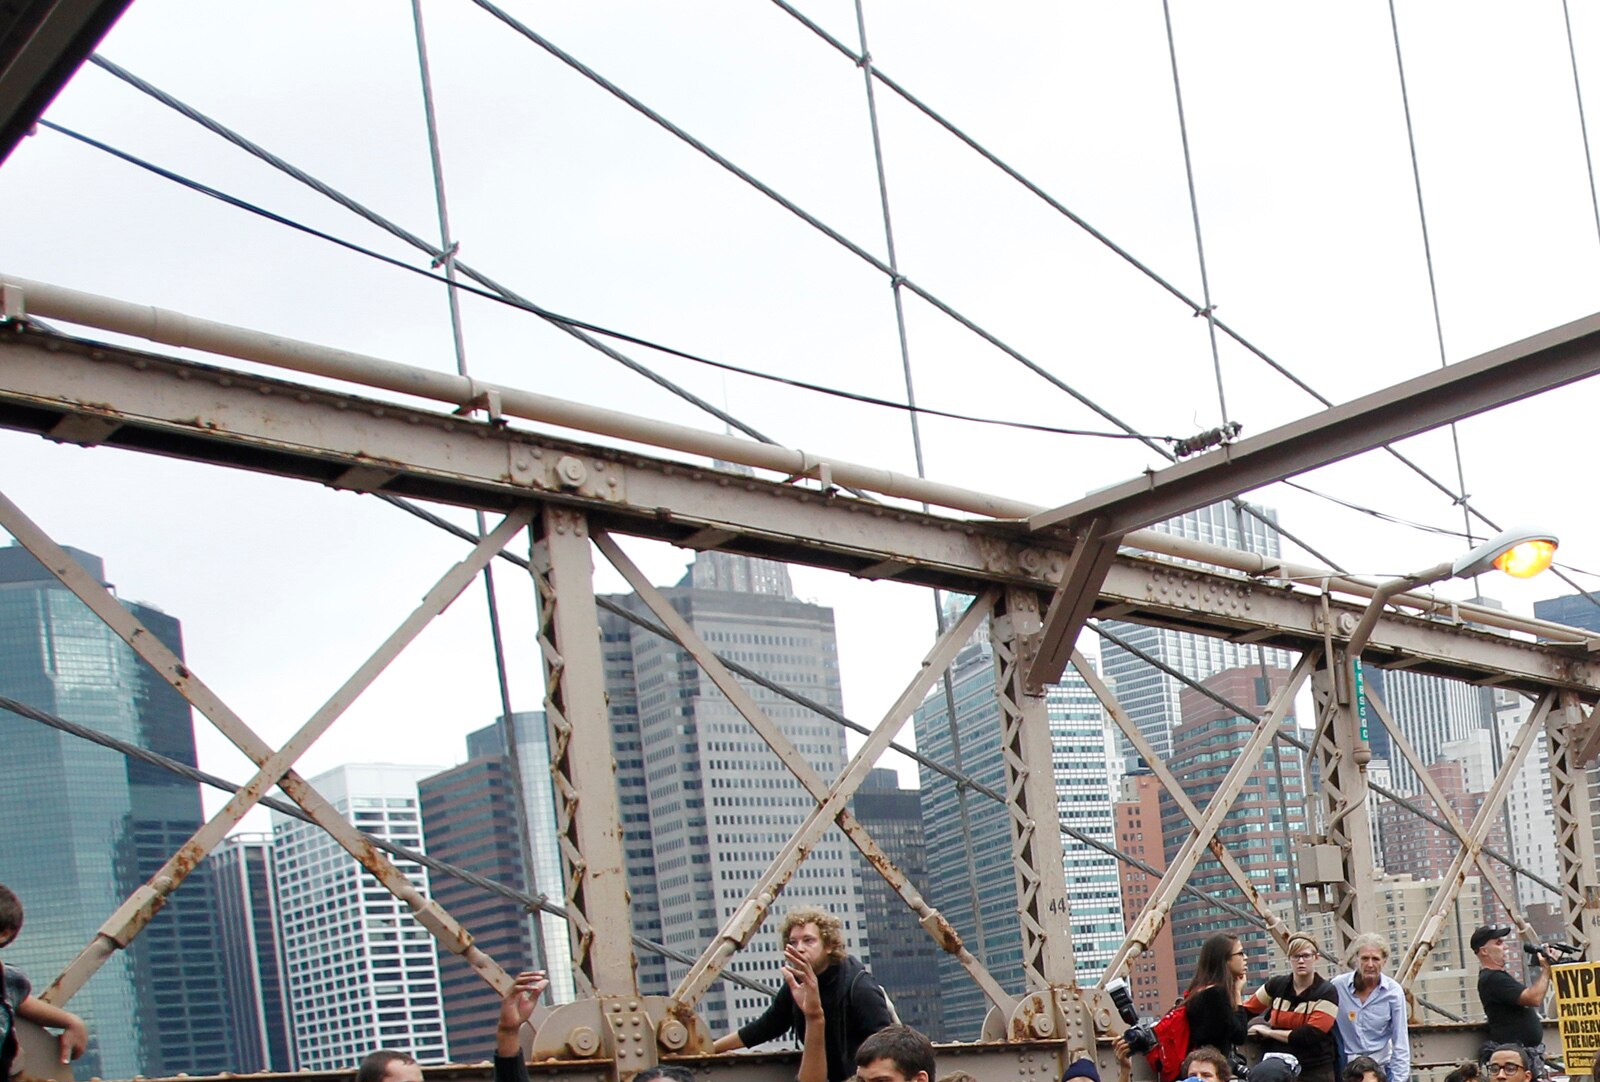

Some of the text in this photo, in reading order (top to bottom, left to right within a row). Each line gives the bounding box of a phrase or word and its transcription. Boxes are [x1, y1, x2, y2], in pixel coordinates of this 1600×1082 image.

[1049, 897, 1066, 915] 44
[1563, 1020, 1580, 1034] AND
[1564, 1034, 1600, 1048] THE RICH
